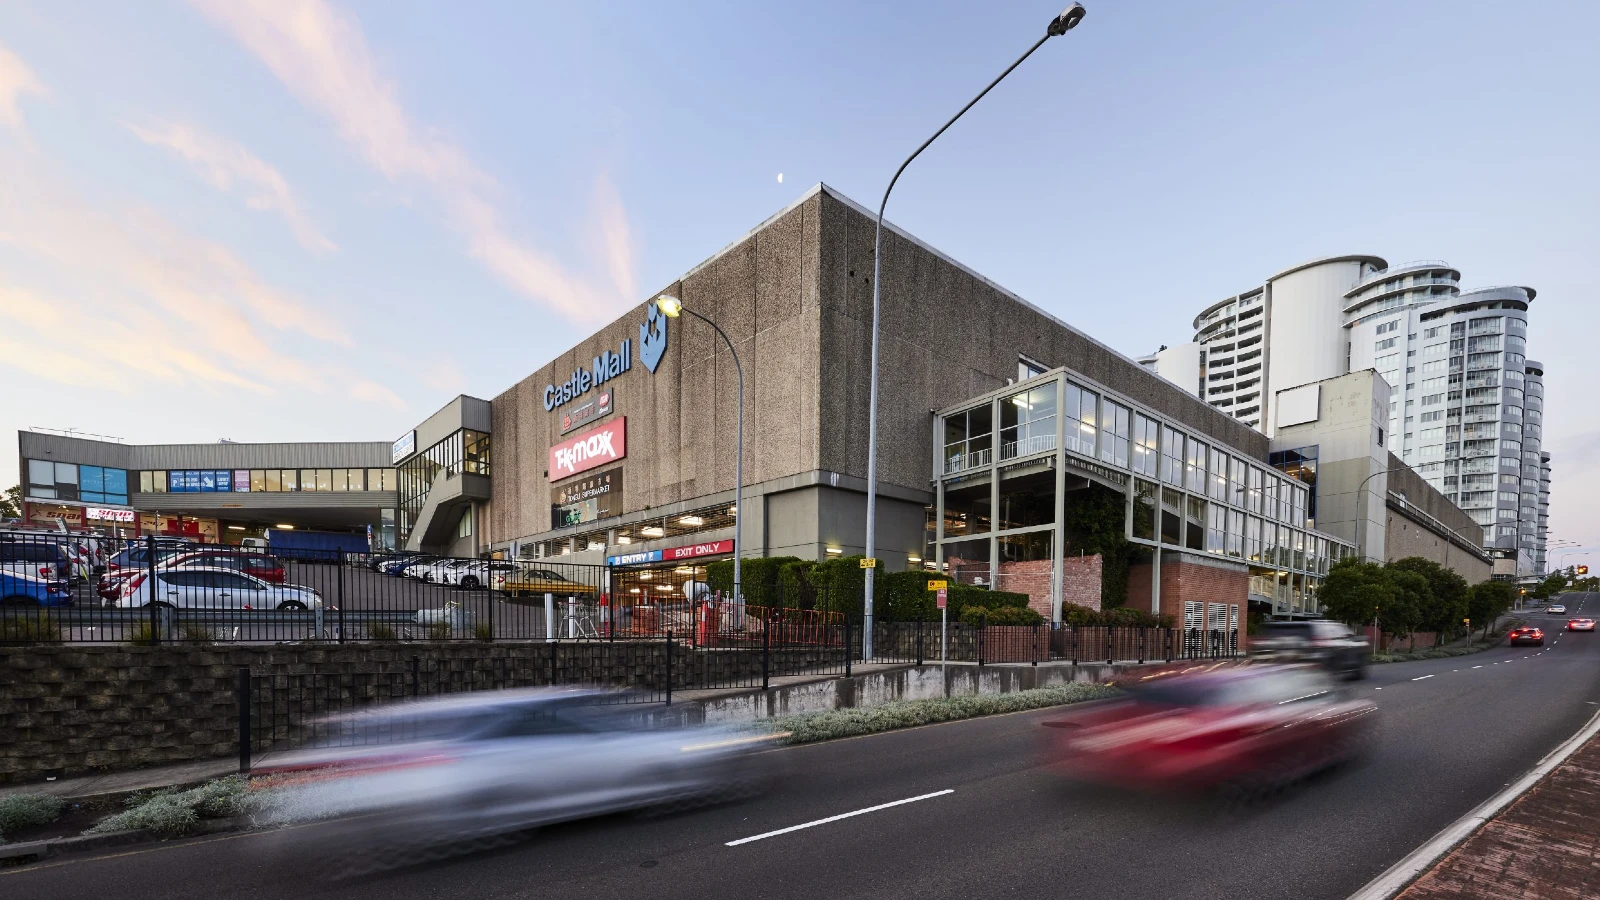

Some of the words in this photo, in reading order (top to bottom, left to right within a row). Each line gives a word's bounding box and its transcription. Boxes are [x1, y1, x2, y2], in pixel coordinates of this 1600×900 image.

[543, 367, 592, 412] Castle
[593, 338, 631, 387] Mall
[675, 547, 693, 557] EXIT
[695, 542, 720, 554] ONLY
[621, 553, 647, 564] ENTRY
